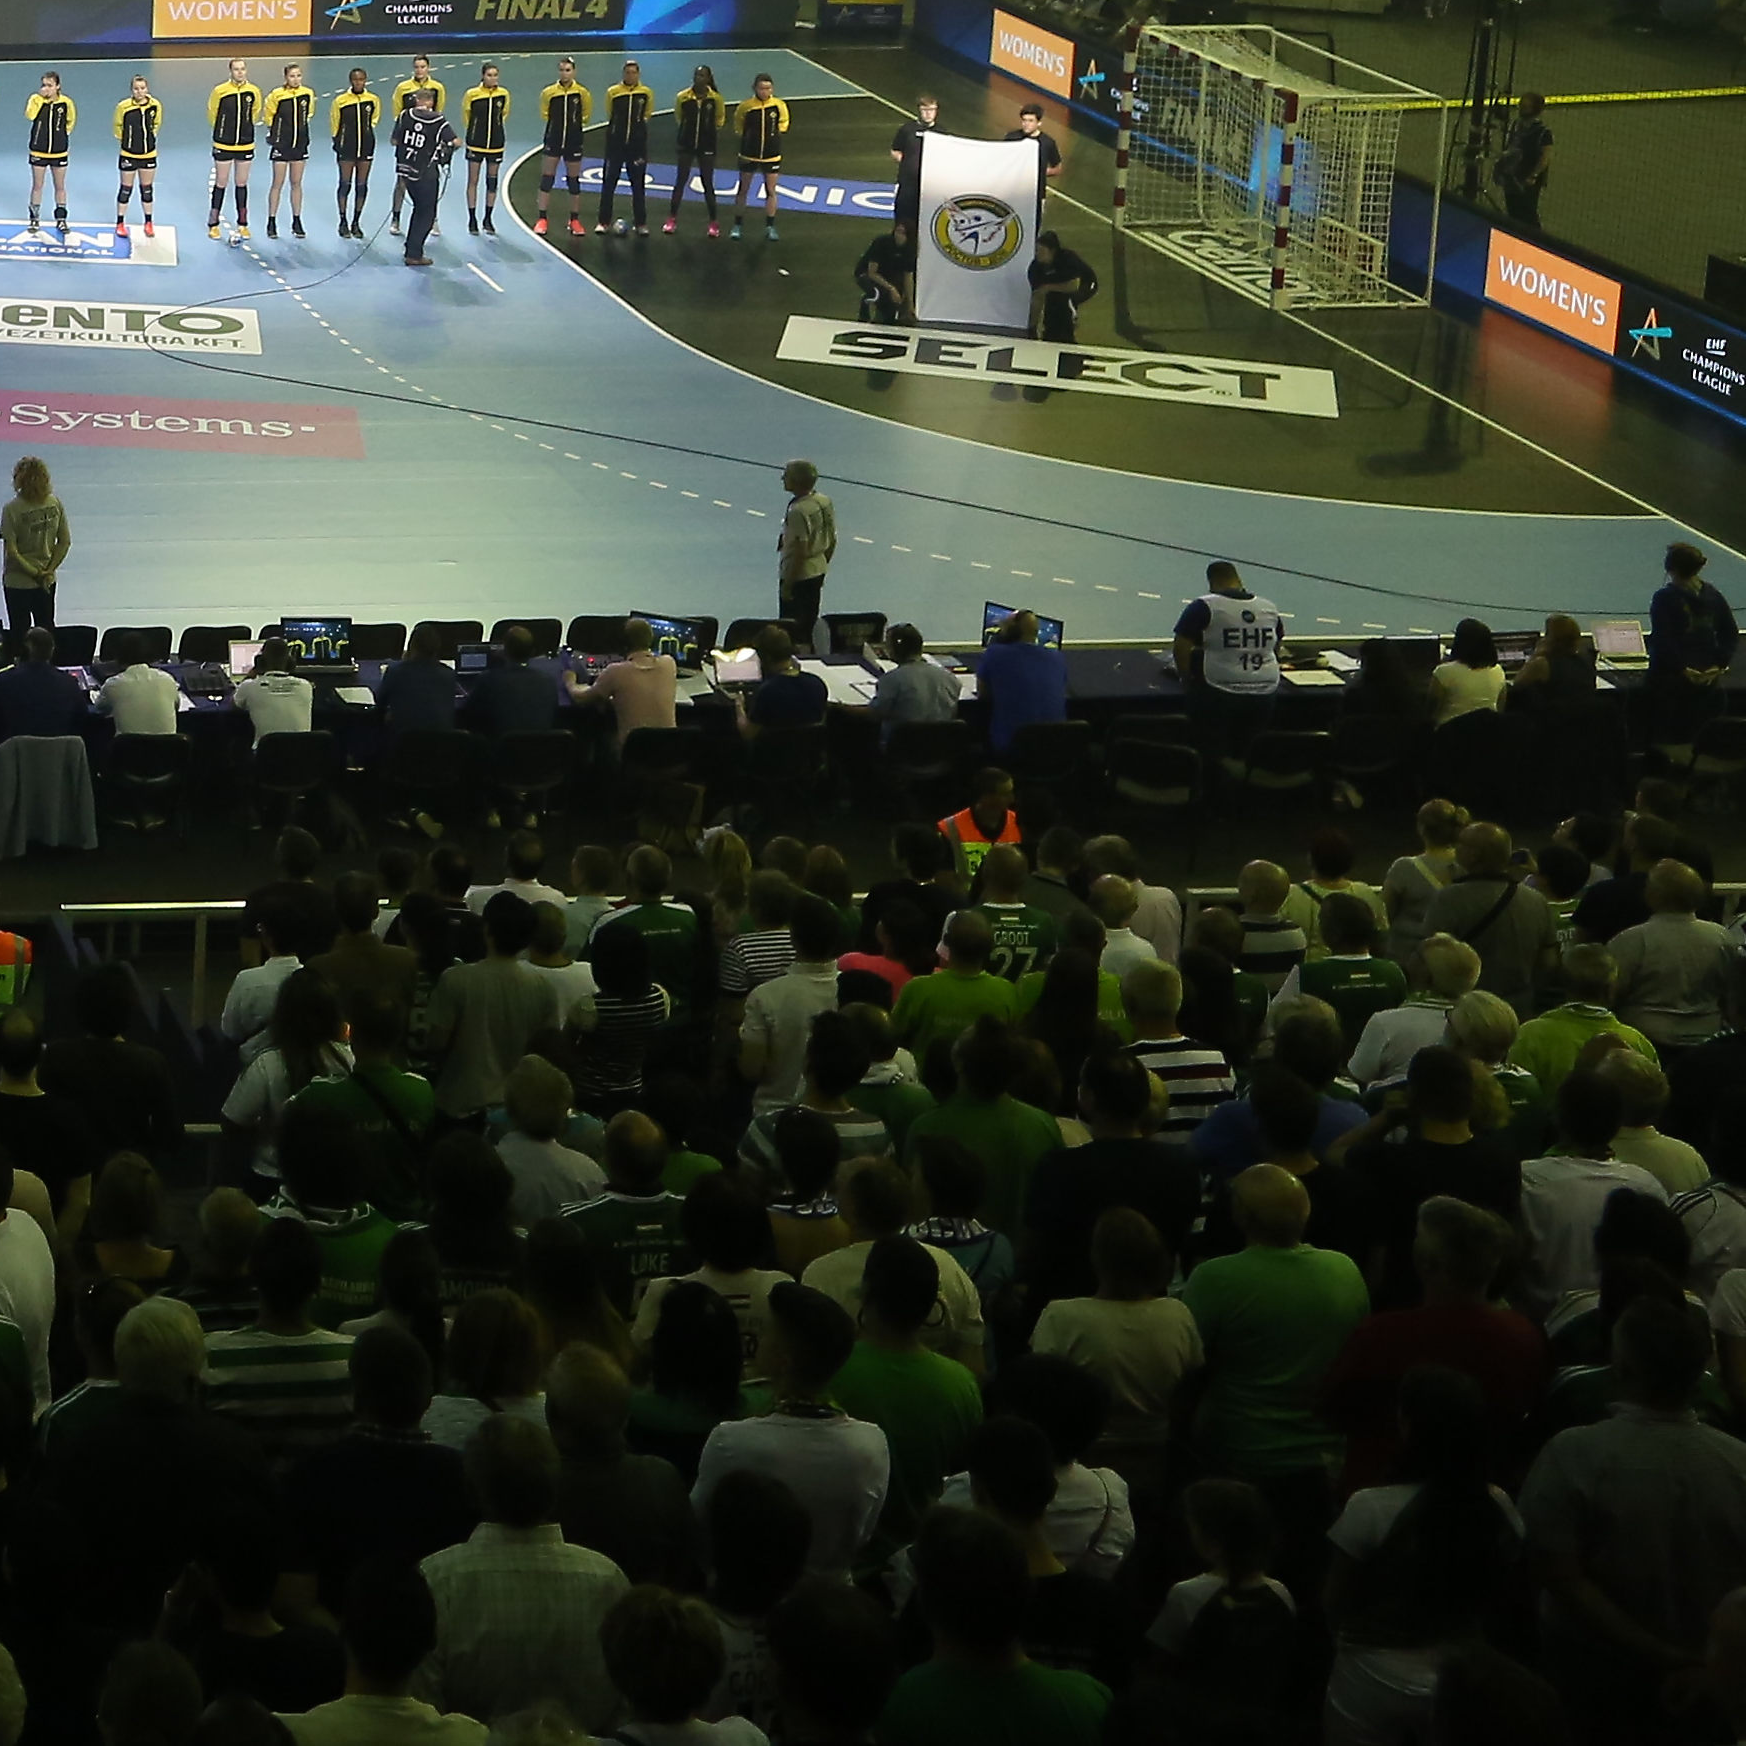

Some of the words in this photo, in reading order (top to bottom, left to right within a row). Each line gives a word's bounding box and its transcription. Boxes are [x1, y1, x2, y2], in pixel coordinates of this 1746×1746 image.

[168, 0, 298, 21] WOMEN'S
[384, 2, 454, 15] CHAMPIONS
[397, 13, 441, 25] LEAGUE
[998, 29, 1067, 78] WOMEN'S
[404, 130, 426, 149] HB
[1498, 255, 1606, 326] WOMEN'S
[829, 329, 1282, 401] SELECT
[1681, 348, 1746, 386] CHAMPIONS
[1692, 369, 1733, 397] LEAGUE
[1223, 627, 1274, 649] EHF
[1238, 653, 1264, 671] 19
[988, 946, 1038, 978] 27
